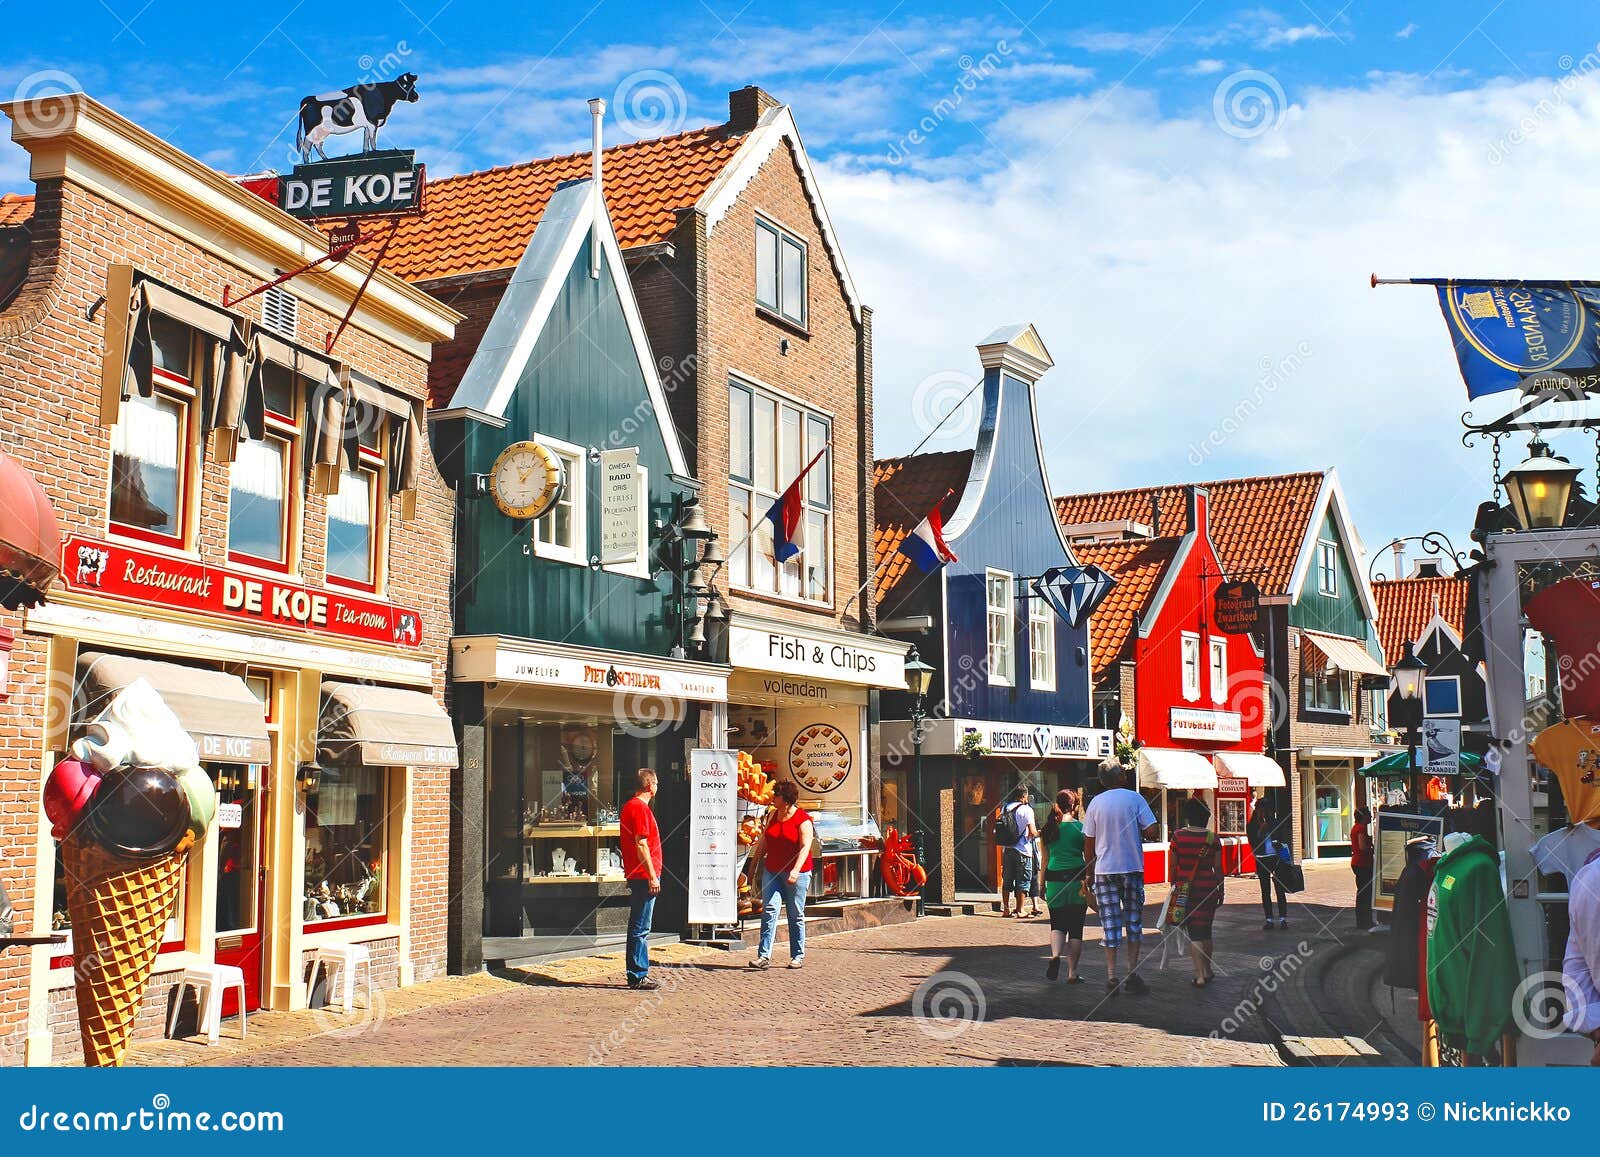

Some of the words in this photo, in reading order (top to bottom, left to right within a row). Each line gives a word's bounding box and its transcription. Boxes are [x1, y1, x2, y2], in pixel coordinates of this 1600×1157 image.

[286, 177, 333, 211] DE
[344, 171, 415, 207] KOE
[609, 462, 631, 470] OMEGA
[609, 473, 631, 481] RADO
[613, 484, 627, 492] ORIS
[123, 558, 213, 598] Restaurant
[222, 577, 262, 611] DE
[272, 586, 328, 624] KOE
[335, 602, 388, 629] Tea-room
[768, 634, 805, 662] Fish
[812, 646, 824, 664] &
[830, 645, 876, 672] Chips
[515, 665, 560, 678] JUWELIER
[584, 665, 606, 683] PIET
[616, 671, 661, 690] SCHILDER
[764, 679, 828, 699] volendam
[204, 735, 221, 754] DE
[226, 738, 252, 757] KOE
[993, 732, 1032, 749] BIESTERVELD
[1055, 735, 1090, 752] DIAMANTAIRS
[424, 747, 436, 762] DE
